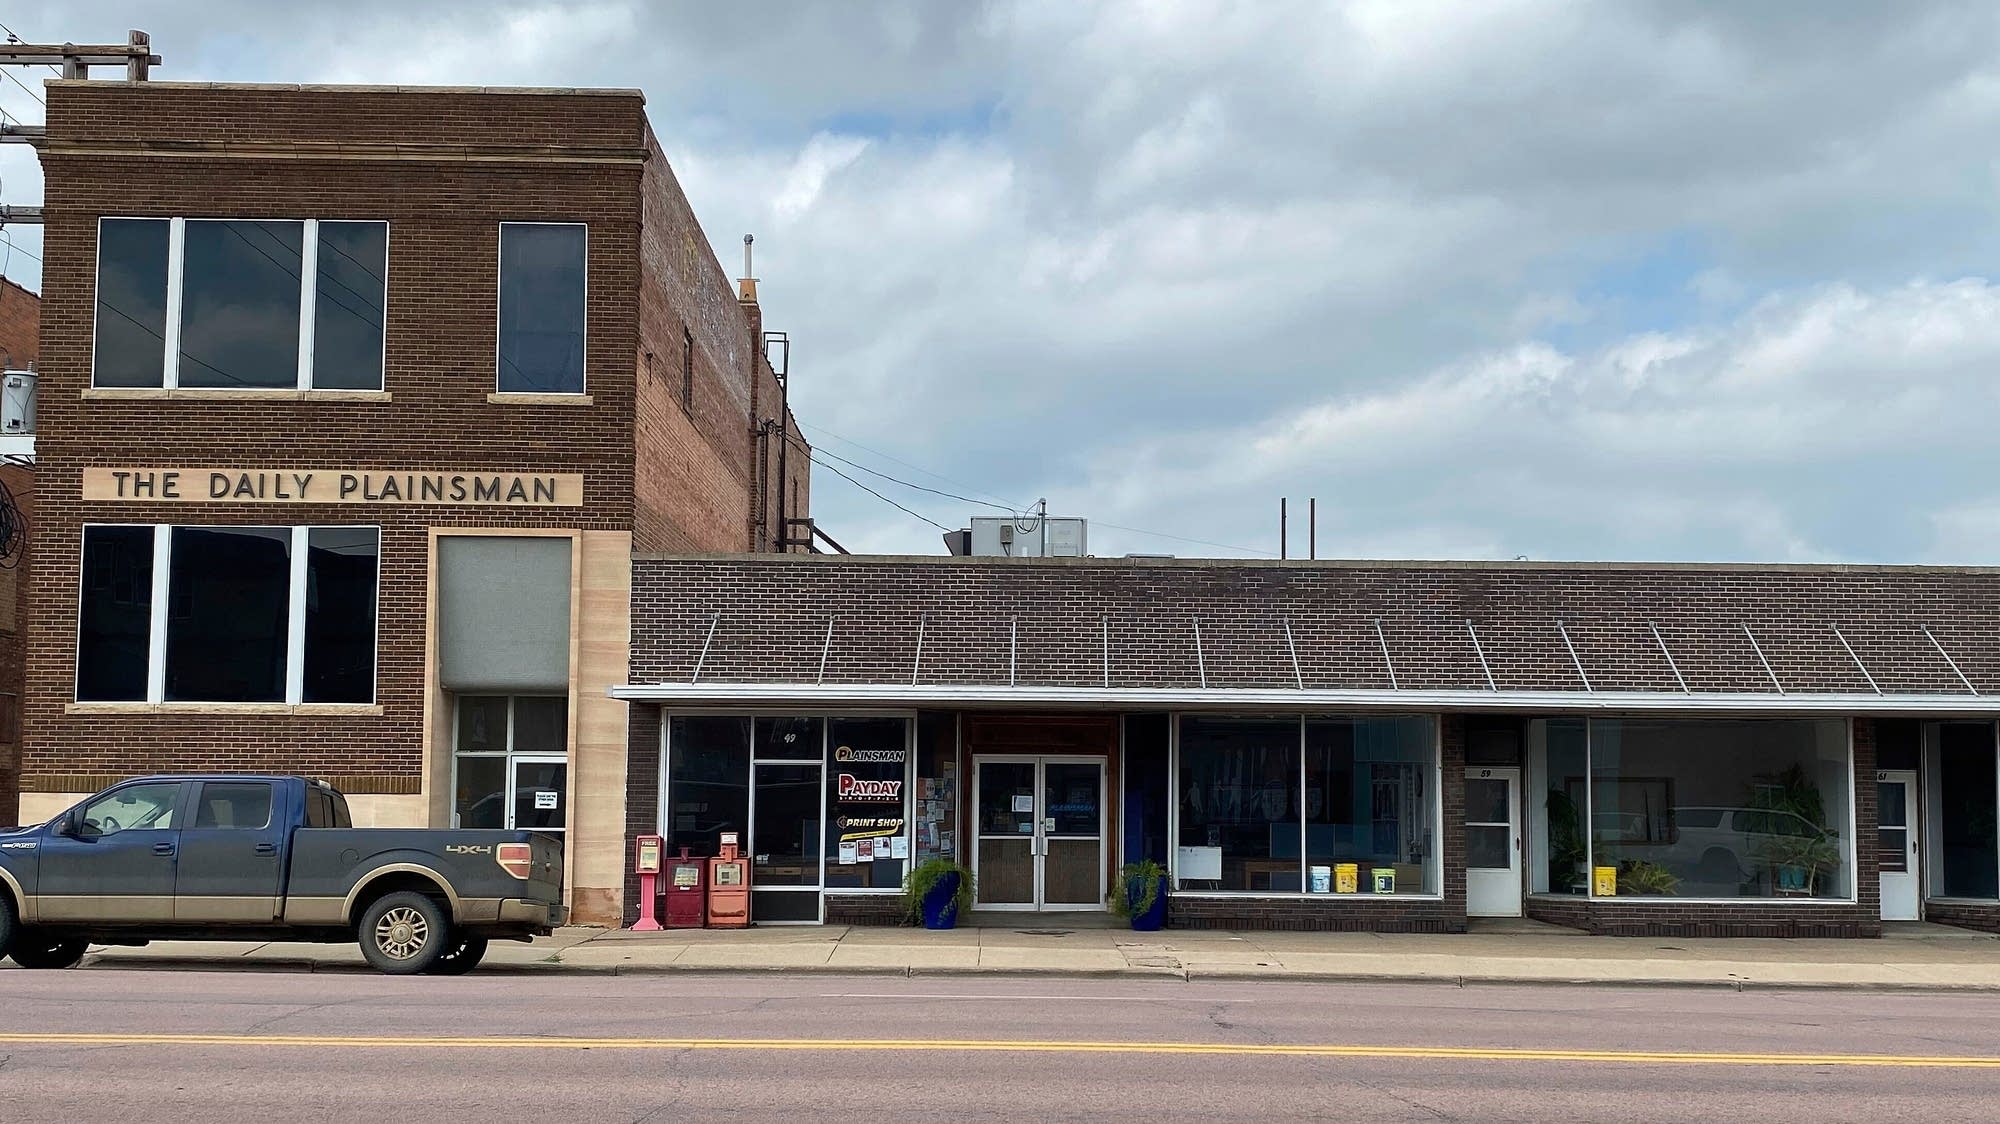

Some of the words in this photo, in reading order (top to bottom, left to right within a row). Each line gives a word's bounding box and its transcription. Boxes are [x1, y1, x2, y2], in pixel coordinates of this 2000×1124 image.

[112, 472, 180, 497] THE
[209, 473, 312, 498] DAILY
[339, 474, 555, 502] PLAINSMAN
[784, 733, 796, 743] 49
[836, 746, 905, 762] PLAINSMAN
[1481, 769, 1491, 777] 59
[1878, 772, 1888, 781] 61
[839, 774, 901, 796] PAYDAY
[846, 818, 876, 827] PRINT
[876, 818, 904, 828] SHOP
